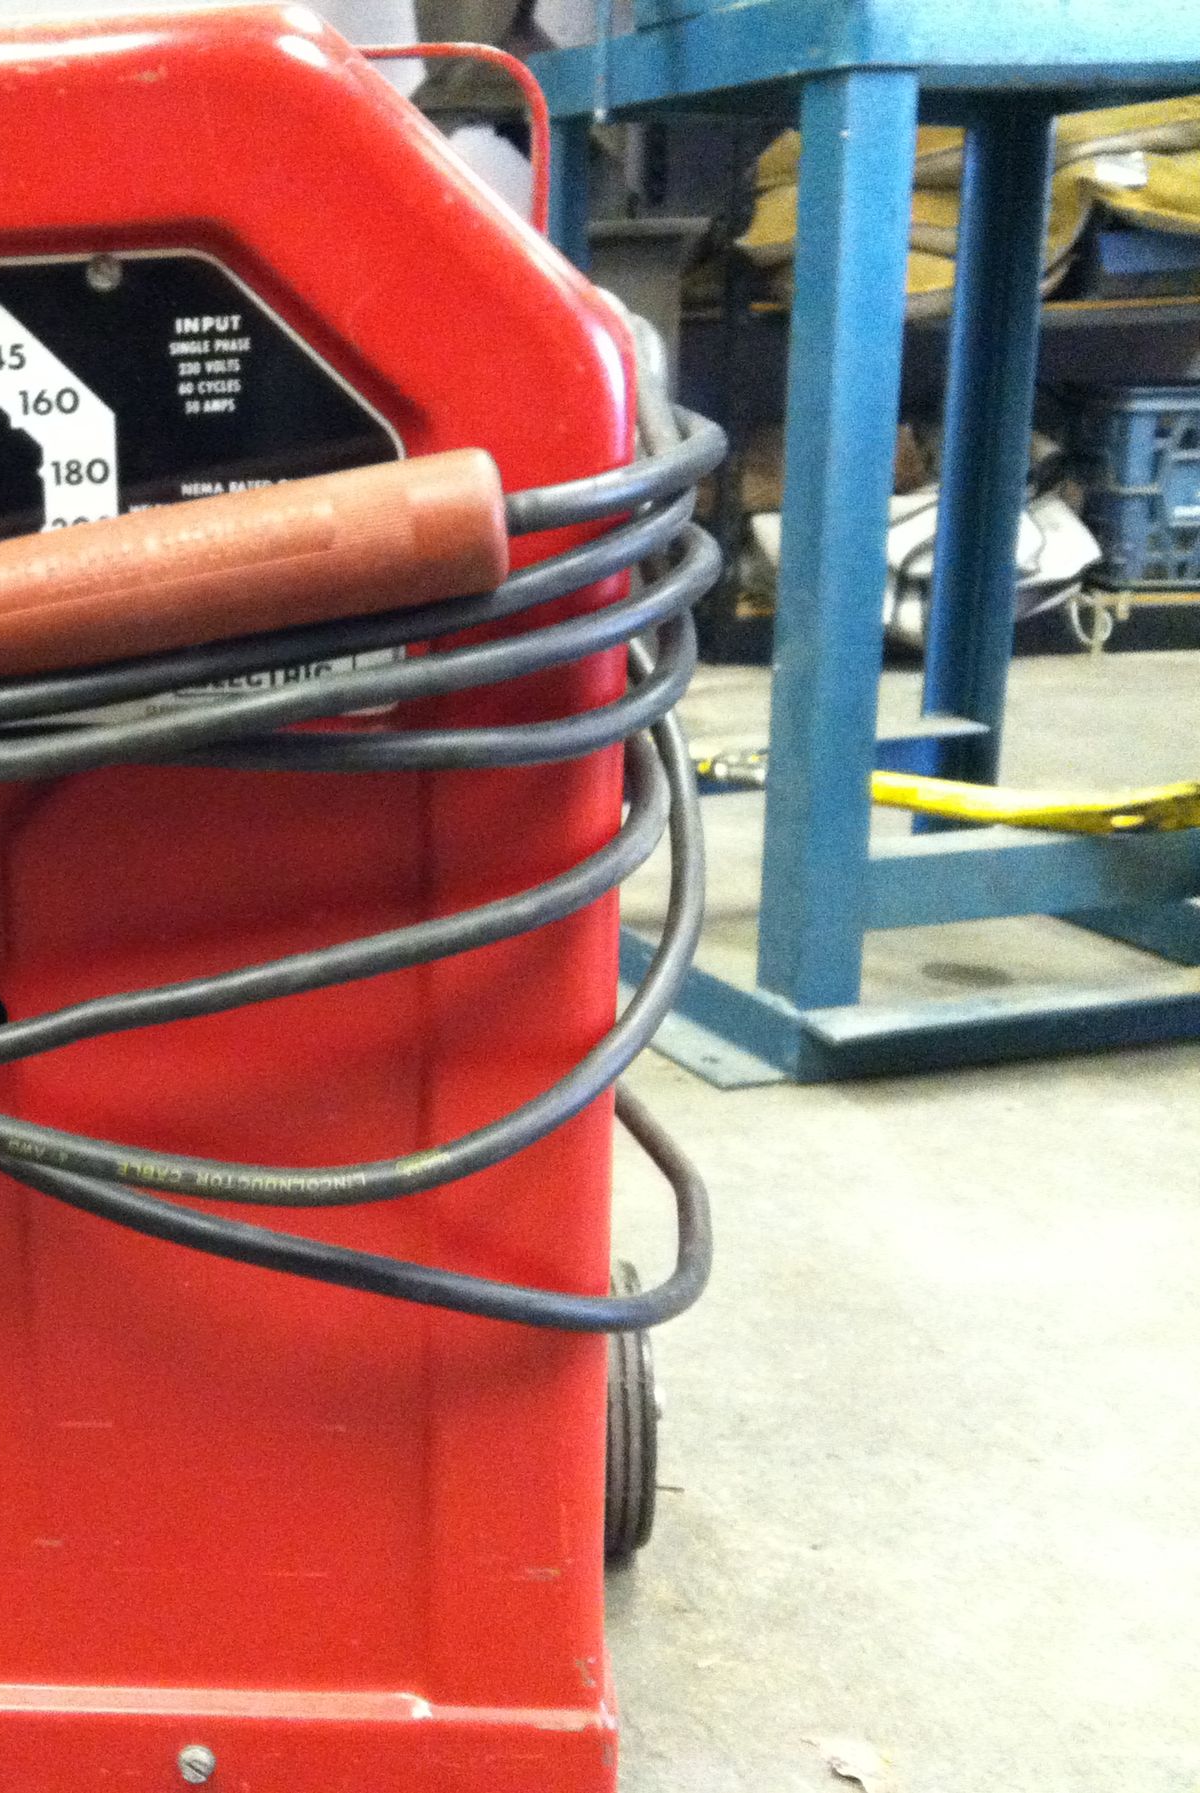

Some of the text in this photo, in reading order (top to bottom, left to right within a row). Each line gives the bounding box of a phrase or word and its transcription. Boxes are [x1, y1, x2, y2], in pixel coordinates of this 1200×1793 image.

[175, 314, 241, 334] INPUT
[169, 337, 251, 355] SINGLE PHASE
[204, 358, 241, 373] VOLTS
[197, 379, 241, 394] CYCLES
[18, 387, 80, 416] 160
[203, 398, 236, 412] AMPS
[51, 459, 110, 487] 180
[118, 1162, 183, 1183] CABLE
